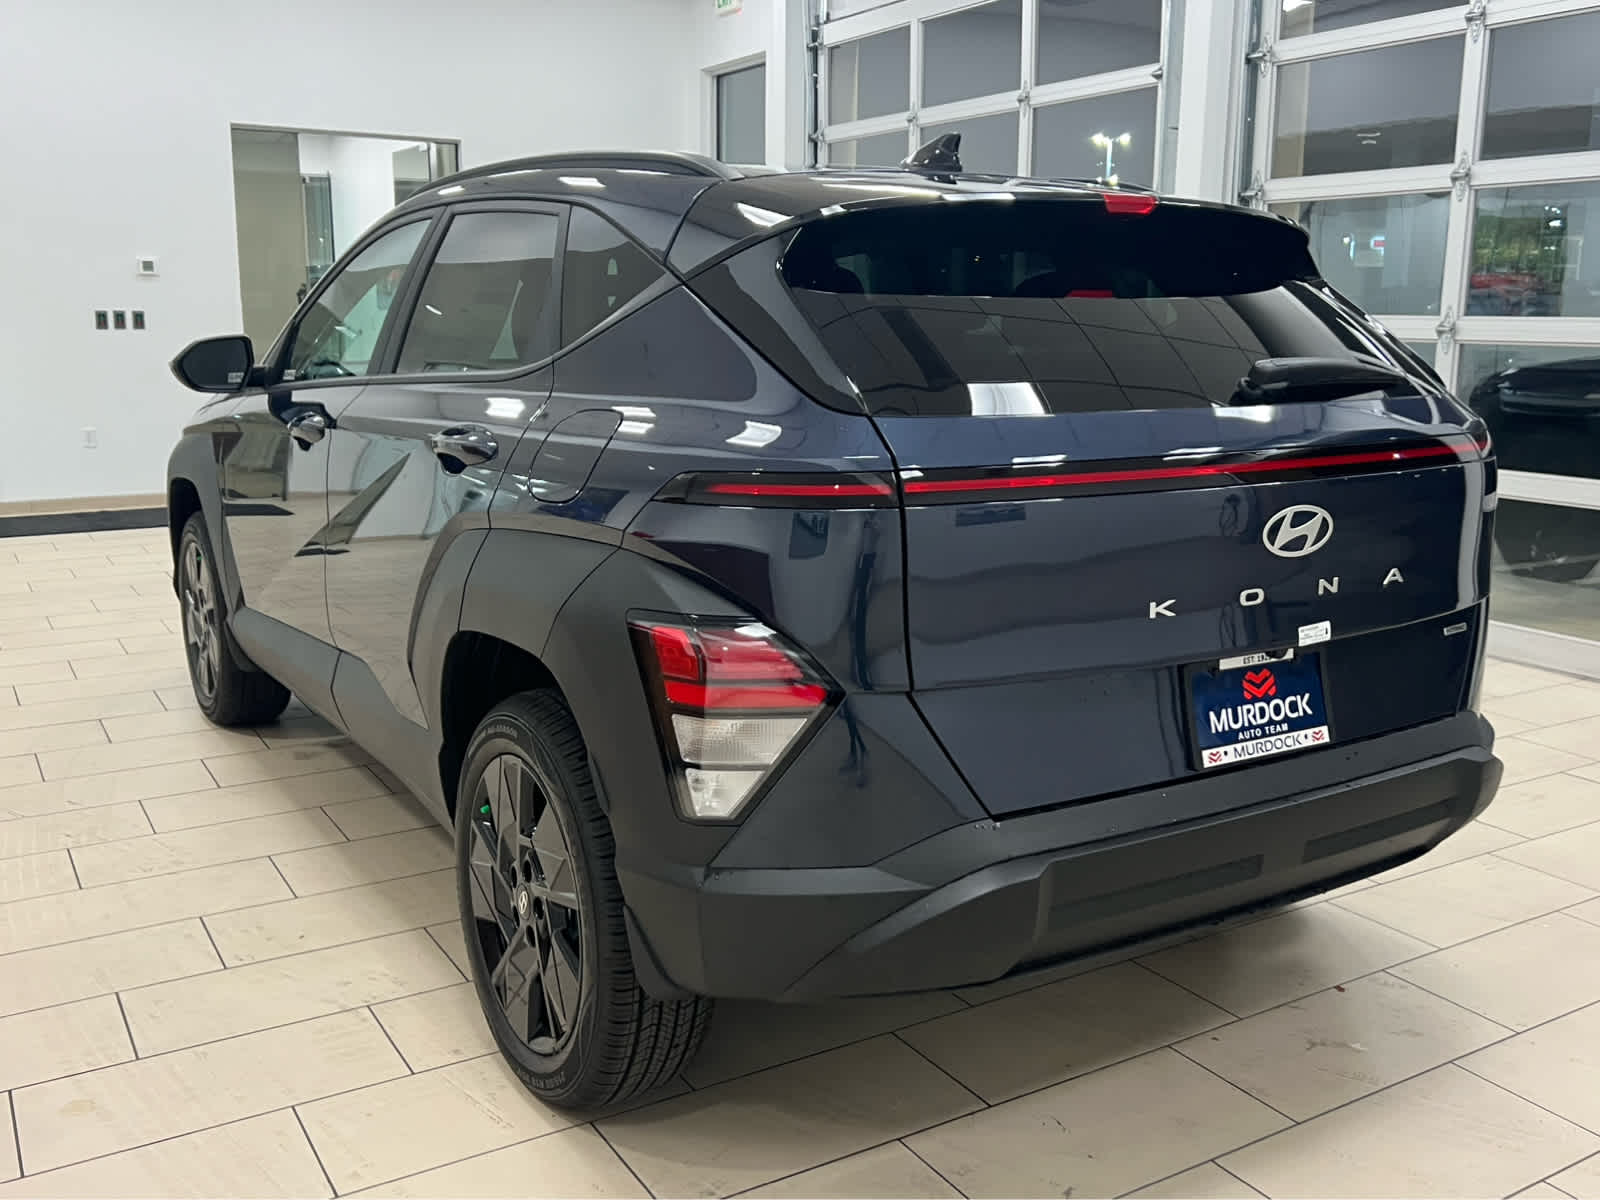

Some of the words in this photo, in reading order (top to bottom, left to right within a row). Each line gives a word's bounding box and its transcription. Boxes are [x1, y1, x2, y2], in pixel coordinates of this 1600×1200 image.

[1149, 567, 1404, 619] KONA
[1208, 693, 1313, 734] MURDOCK
[1233, 735, 1302, 759] MURDOCK
[1238, 728, 1262, 741] AUTO
[1265, 723, 1289, 734] TEAM
